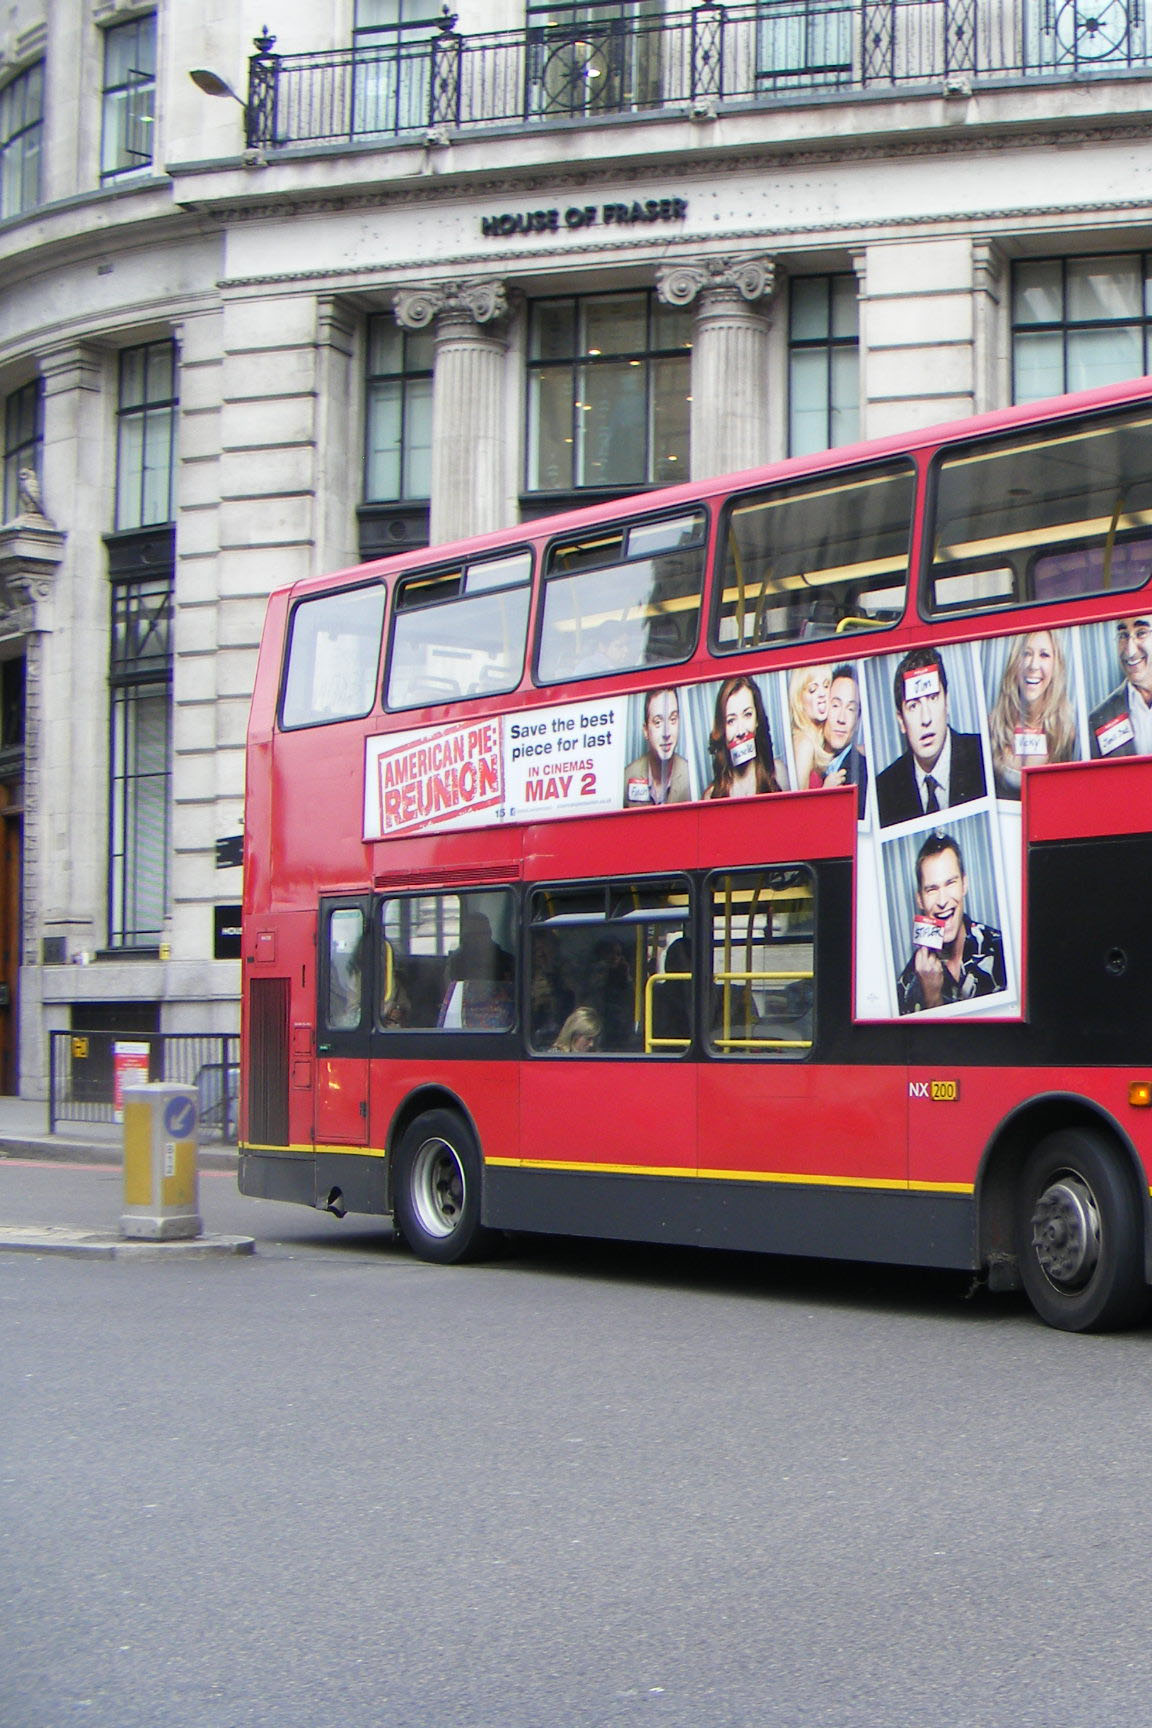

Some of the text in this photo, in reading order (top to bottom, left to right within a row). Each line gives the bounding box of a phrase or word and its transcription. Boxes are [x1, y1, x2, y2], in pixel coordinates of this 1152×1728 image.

[481, 197, 689, 236] HOUSE OF FRASER
[510, 709, 615, 740] Save the best
[384, 724, 498, 789] AMERICAN PIE:
[512, 731, 612, 762] piece for last
[528, 758, 594, 778] IN CINEMAS
[385, 754, 499, 828] REUNION
[525, 773, 597, 802] MAY 2
[910, 1082, 955, 1098] NX 200
